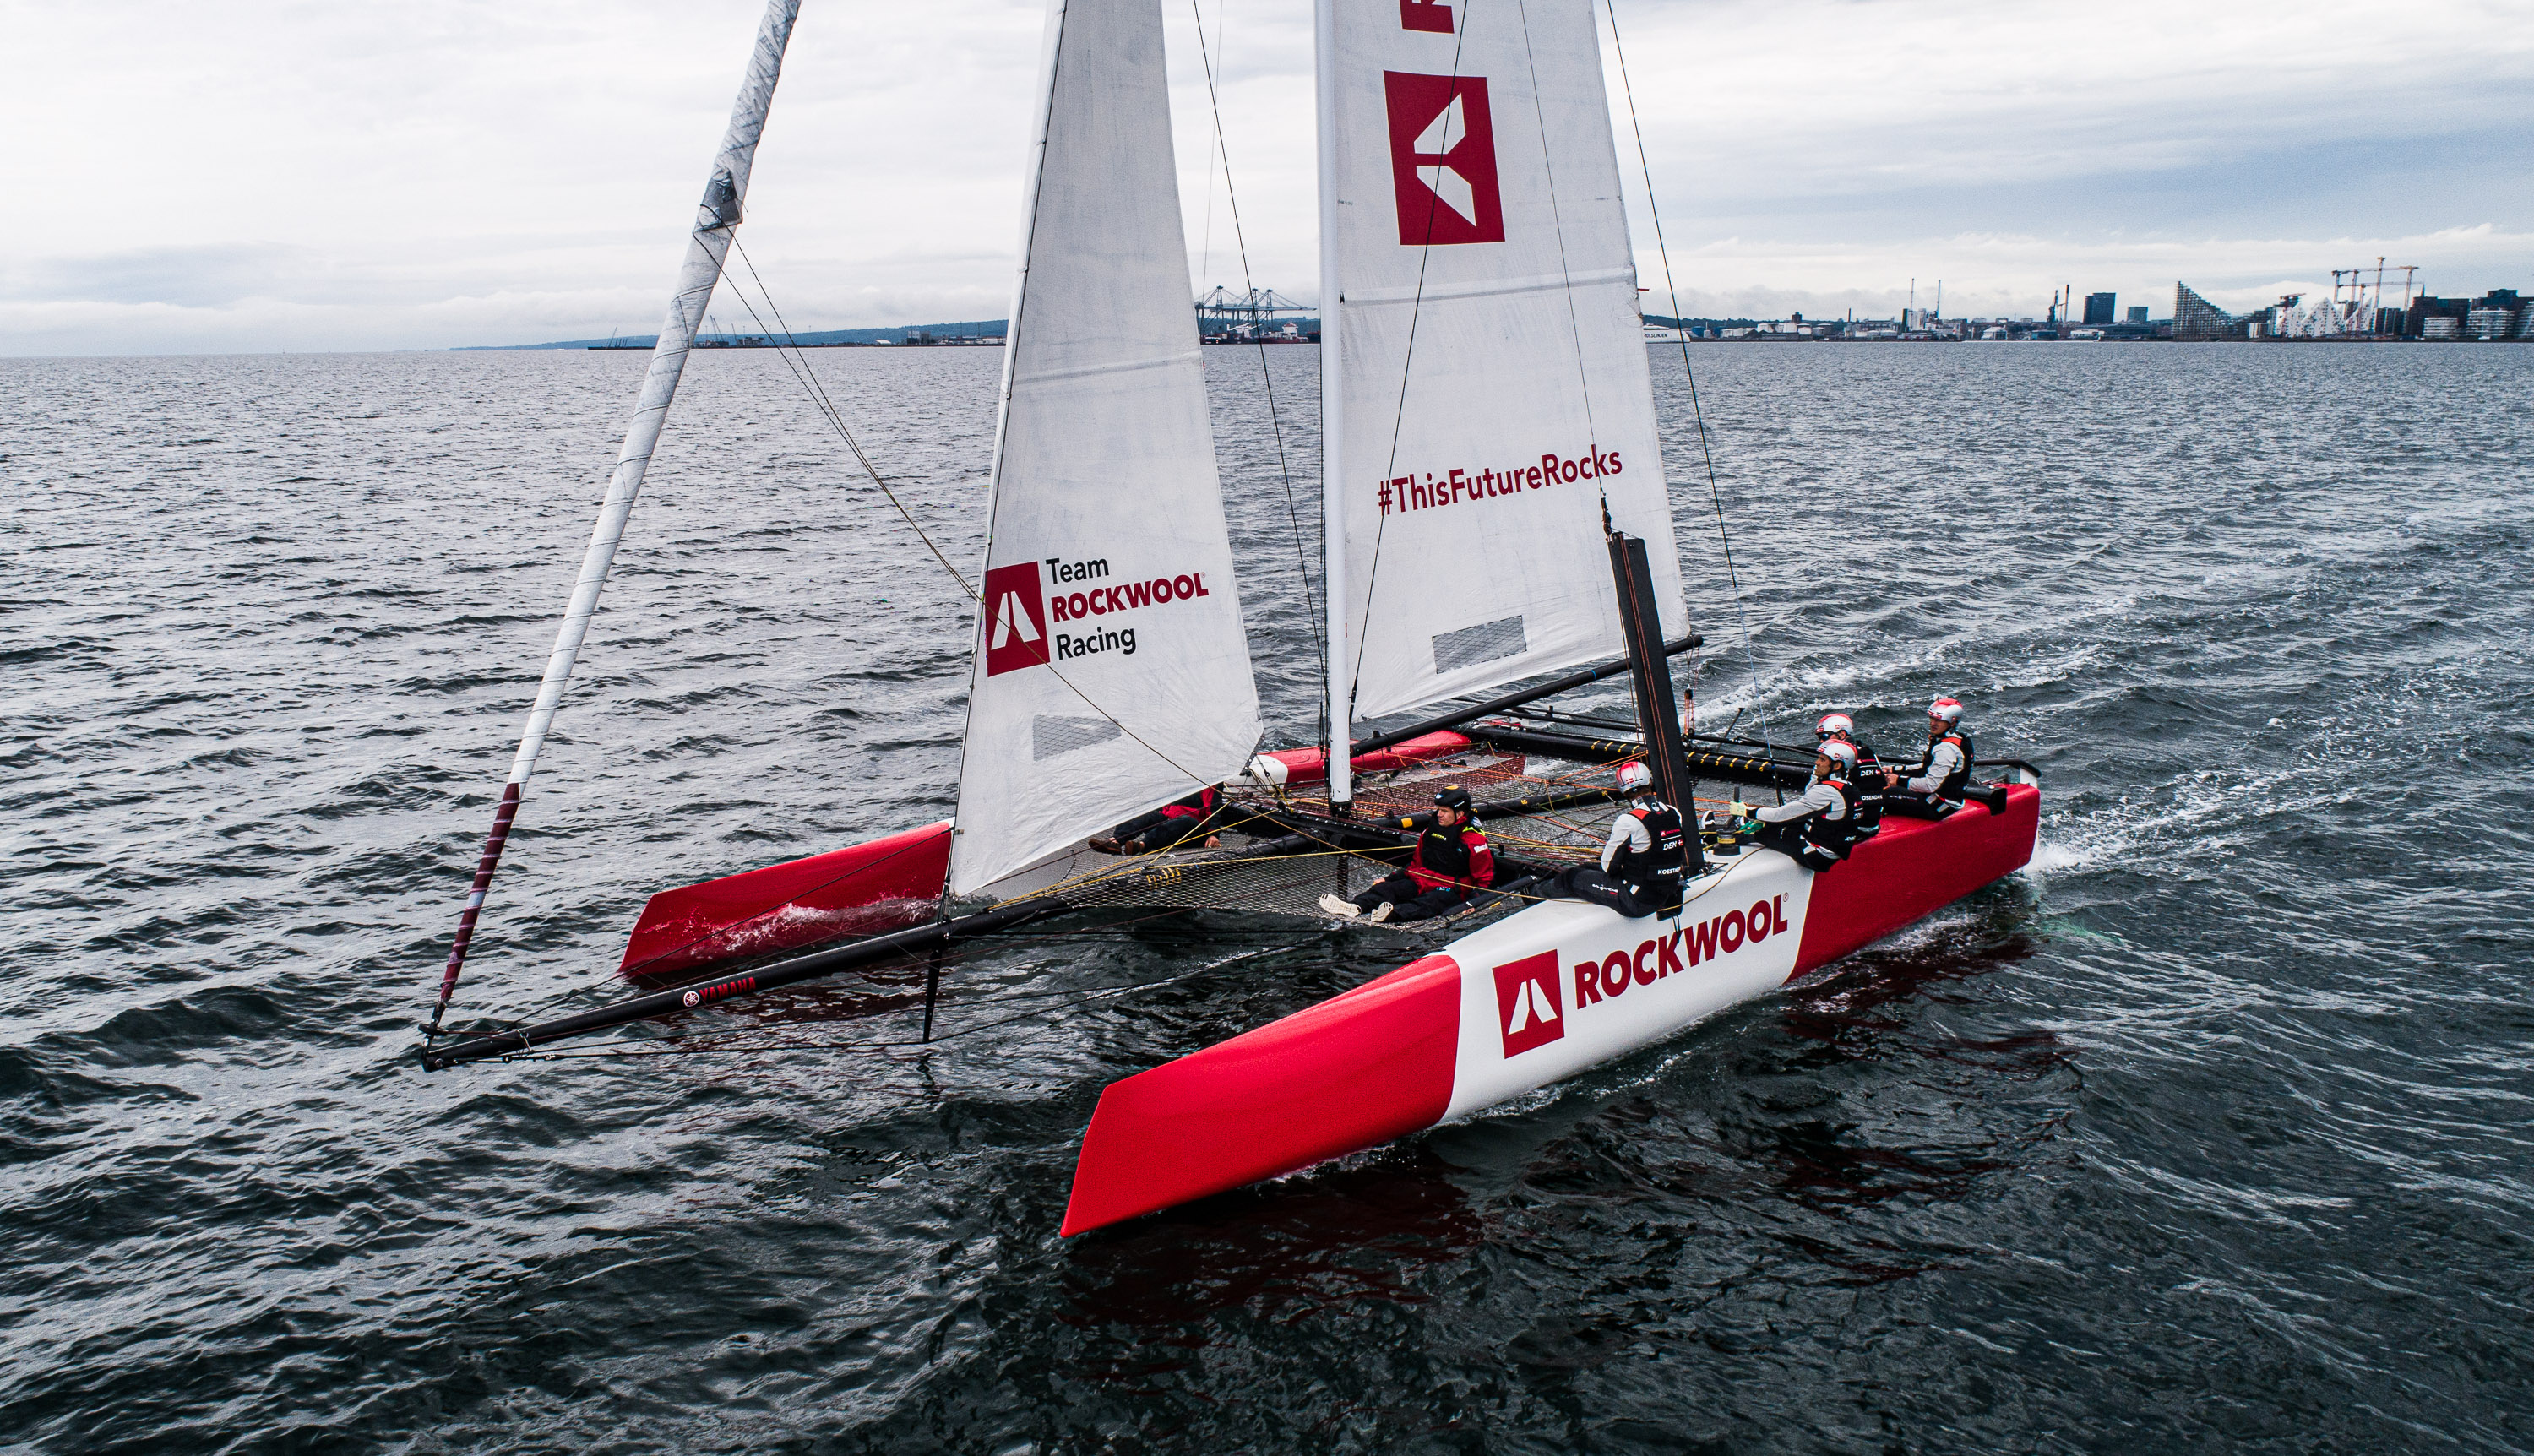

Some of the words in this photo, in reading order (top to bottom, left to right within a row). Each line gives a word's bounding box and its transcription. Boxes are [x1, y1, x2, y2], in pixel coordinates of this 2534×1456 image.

[1378, 443, 1623, 516] #ThisFutureRocks
[1046, 557, 1110, 584] Team
[1056, 627, 1137, 660] Racing
[699, 977, 756, 1002] YAMAHA
